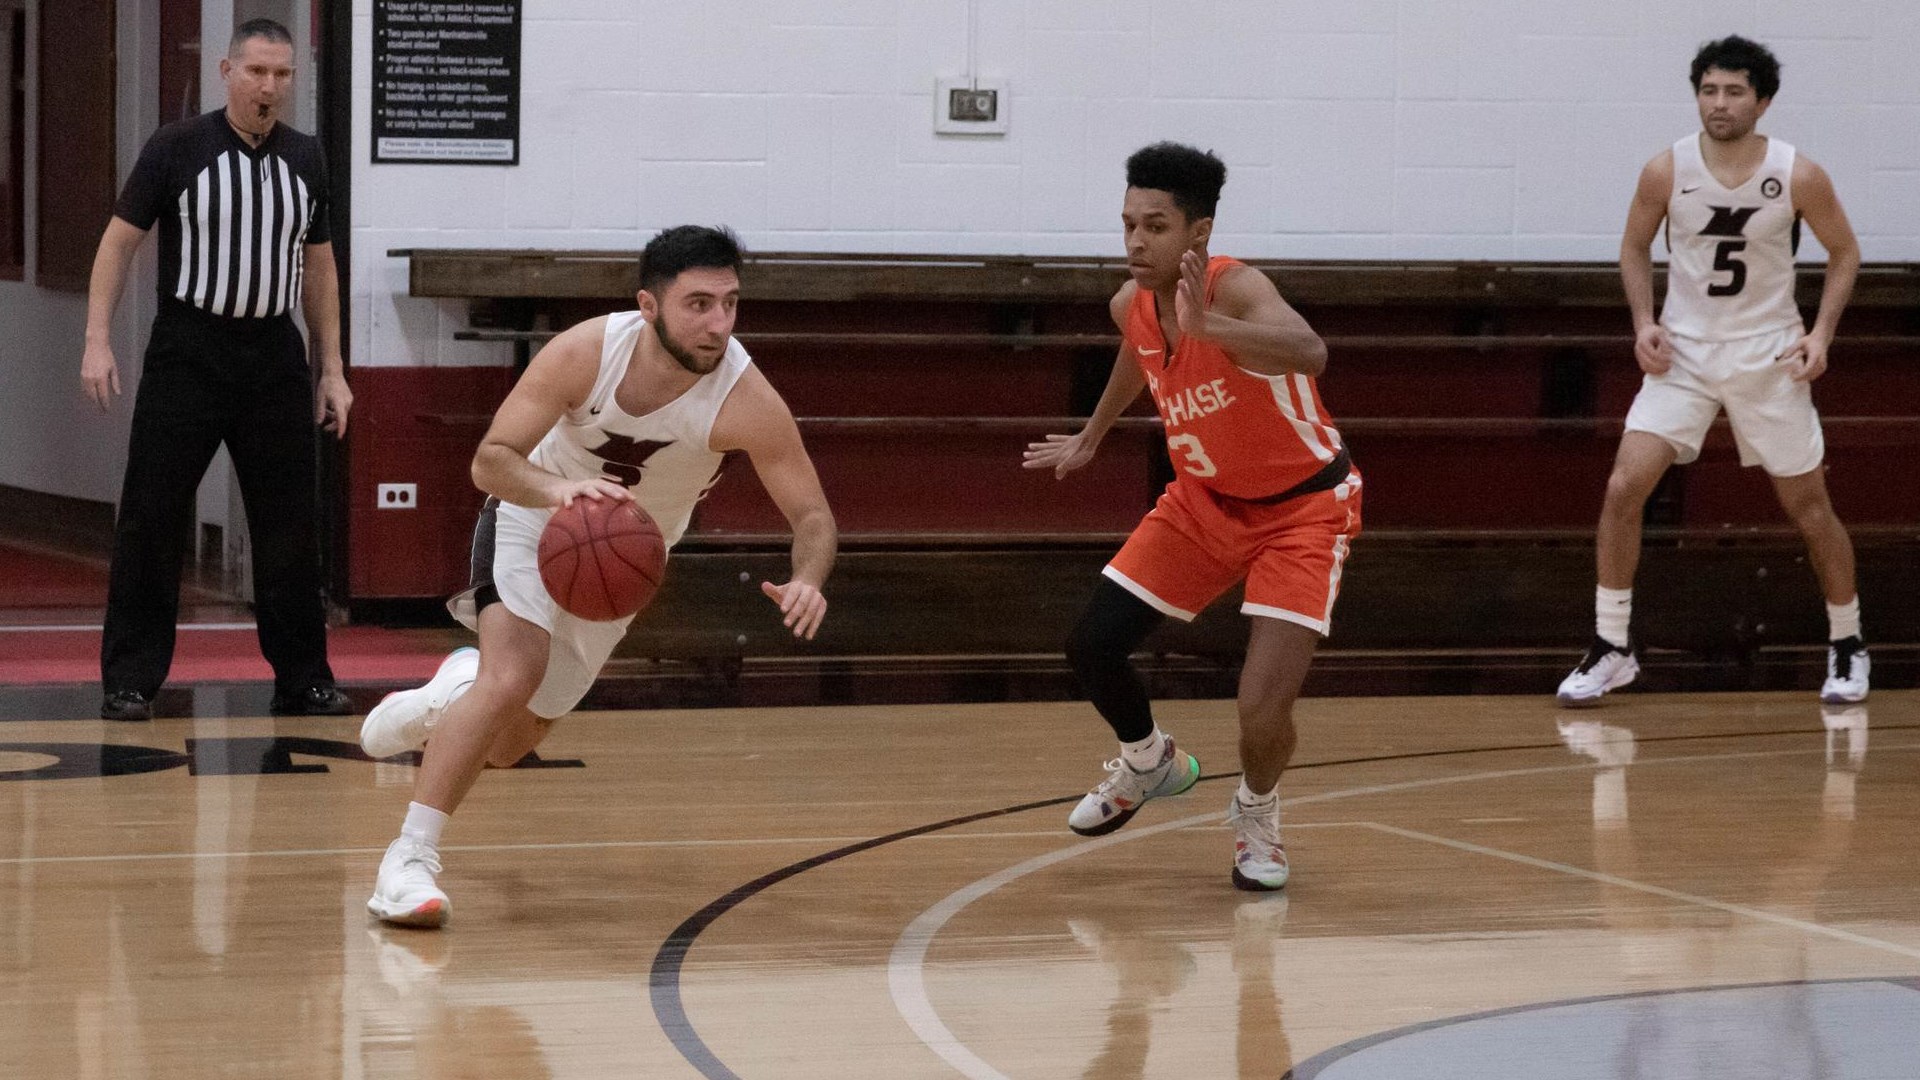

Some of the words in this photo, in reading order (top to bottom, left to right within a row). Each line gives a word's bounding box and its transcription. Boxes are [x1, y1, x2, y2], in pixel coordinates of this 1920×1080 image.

[387, 3, 408, 11] Usage
[410, 3, 417, 11] of
[418, 3, 429, 11] the
[430, 3, 445, 11] gym
[446, 3, 463, 12] must
[465, 3, 473, 12] be
[506, 4, 514, 12] in
[419, 14, 433, 22] with
[446, 15, 472, 23] Athletic
[473, 15, 512, 23] Department
[388, 29, 401, 38] Two
[426, 30, 438, 38] per
[388, 41, 412, 49] student
[414, 41, 440, 49] allowed
[386, 55, 410, 64] Proper
[410, 56, 436, 64] athletic
[436, 56, 466, 65] footwear
[467, 56, 474, 65] is
[474, 57, 503, 65] required
[386, 66, 394, 74] at
[394, 66, 403, 74] all
[439, 67, 449, 75] no
[490, 68, 510, 76] shoes
[386, 81, 396, 90] No
[397, 81, 424, 90] hanging
[426, 82, 435, 91] on
[436, 82, 470, 91] basketball
[428, 94, 436, 102] or
[437, 94, 455, 102] other
[456, 94, 471, 102] gym
[472, 95, 508, 103] equipment
[386, 109, 396, 118] No
[440, 110, 470, 118] alcoholic
[472, 111, 506, 119] beverages
[386, 120, 394, 129] or
[394, 120, 416, 129] unruly
[417, 120, 447, 129] behavior
[448, 121, 475, 130] allowed
[1707, 240, 1747, 297] 5
[1167, 433, 1217, 478] 3
